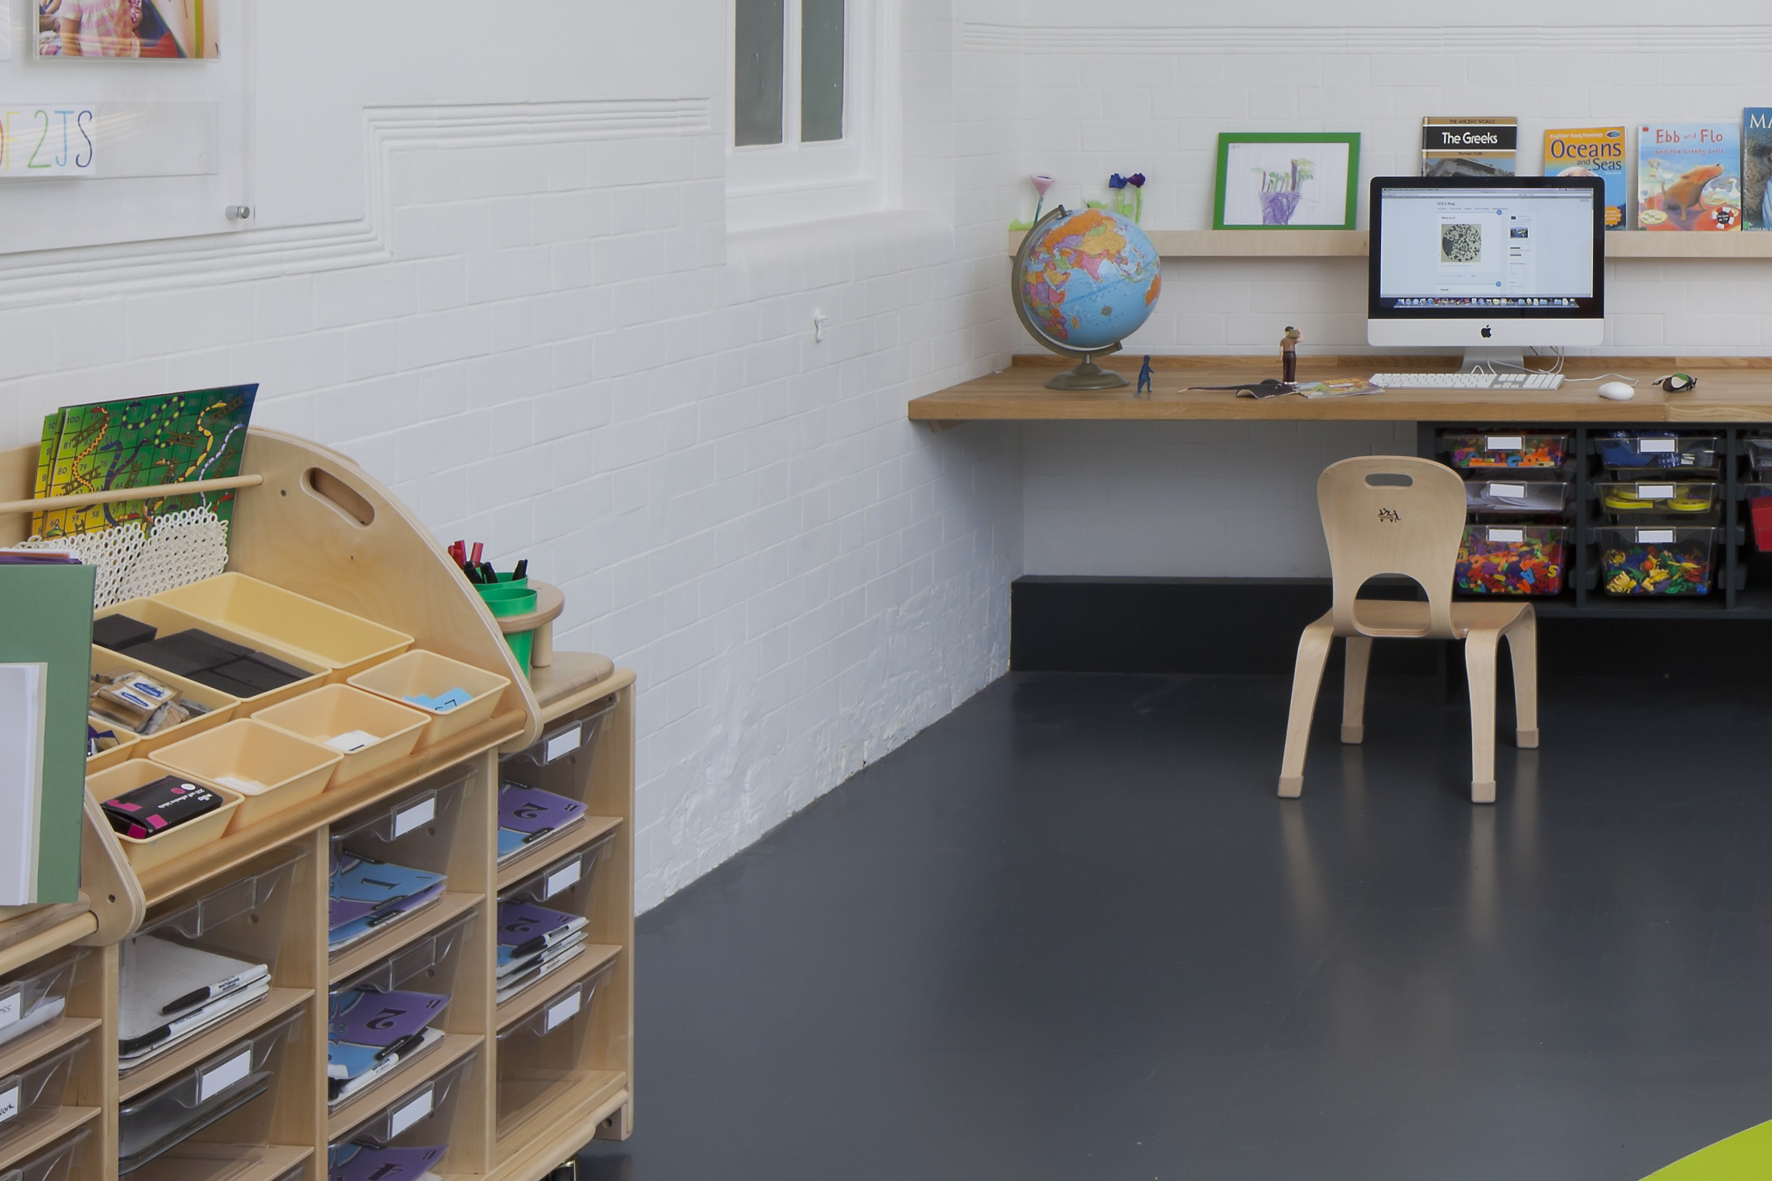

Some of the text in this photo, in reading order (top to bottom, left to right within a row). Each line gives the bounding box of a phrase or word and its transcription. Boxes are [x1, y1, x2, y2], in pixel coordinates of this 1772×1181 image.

[27, 109, 94, 169] 2JS
[1442, 131, 1498, 144] The Greeks
[1656, 129, 1680, 144] Ebb
[1700, 129, 1723, 143] Flo
[1550, 139, 1622, 159] Oceans
[1592, 158, 1622, 171] Seas
[66, 415, 80, 424] 100
[63, 441, 71, 449] 81
[57, 467, 68, 476] 80
[80, 463, 88, 471] 79
[92, 511, 100, 519] 58
[112, 506, 120, 514] 57
[50, 519, 60, 527] 60
[513, 801, 549, 819] 2
[360, 877, 402, 890] 1
[504, 916, 540, 932] 2
[366, 1007, 407, 1030] 2
